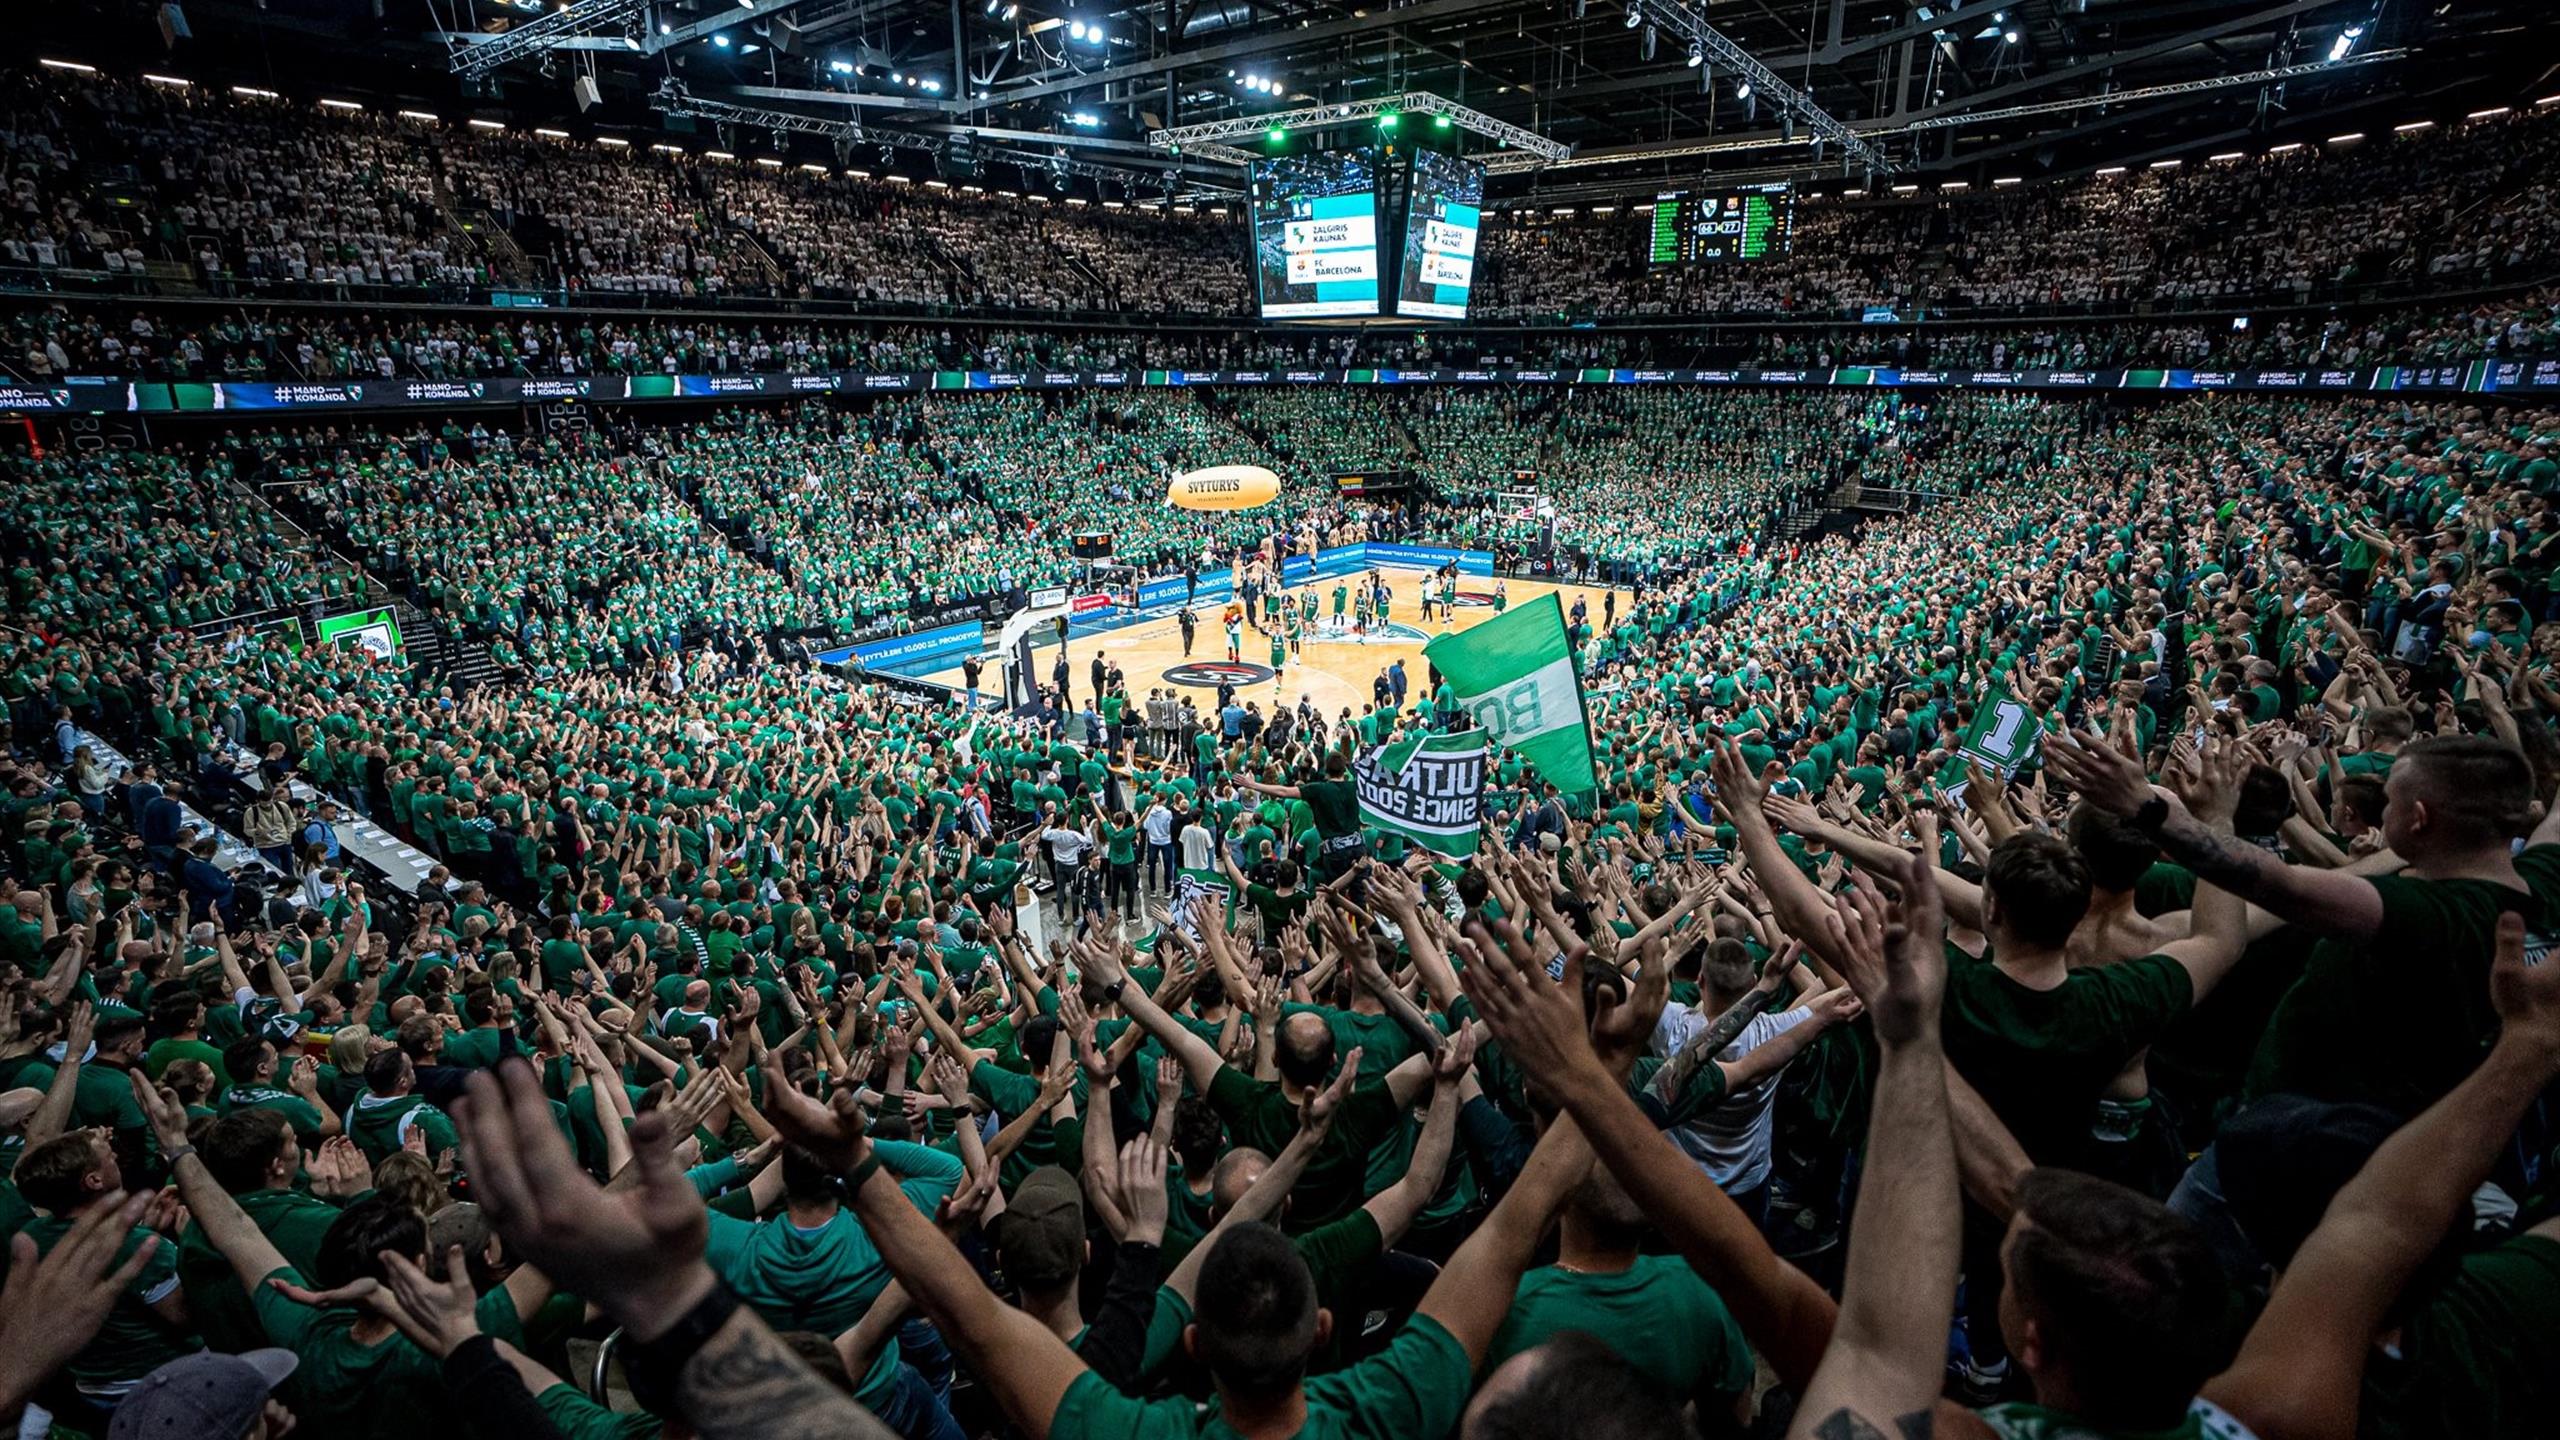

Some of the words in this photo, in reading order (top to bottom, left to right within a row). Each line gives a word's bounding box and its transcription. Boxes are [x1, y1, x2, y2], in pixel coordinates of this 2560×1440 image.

[1313, 234, 1347, 242] KAUNAS
[1315, 266, 1362, 276] BARCELONA
[424, 389, 470, 398] KOMANDA
[536, 387, 578, 396] KOMANDA
[294, 393, 347, 402] KOMANDA
[1979, 699, 2024, 760] 1
